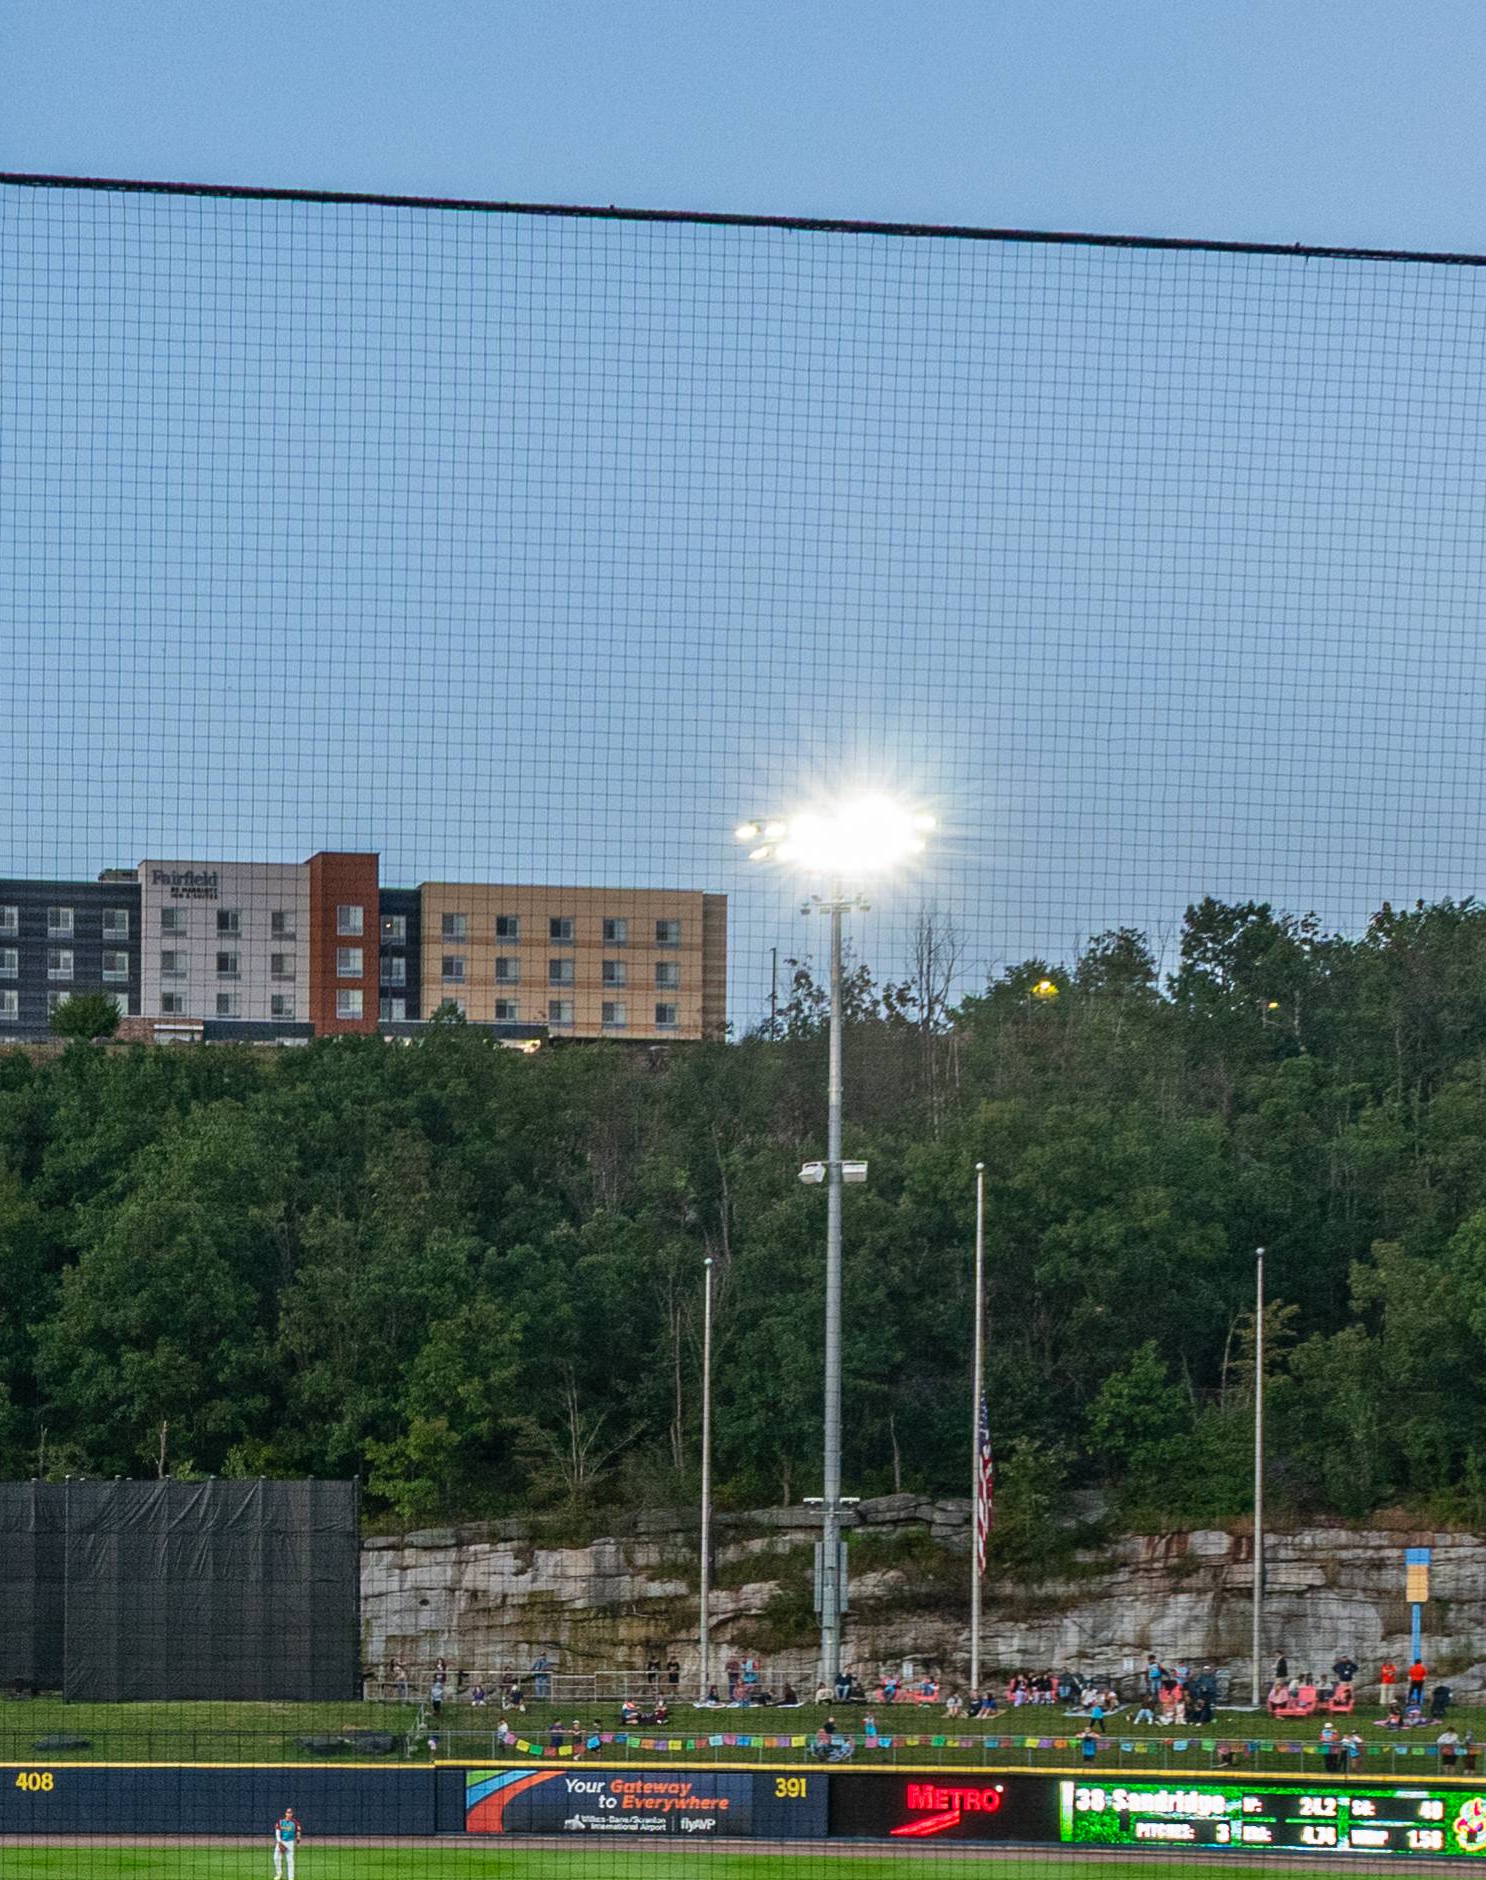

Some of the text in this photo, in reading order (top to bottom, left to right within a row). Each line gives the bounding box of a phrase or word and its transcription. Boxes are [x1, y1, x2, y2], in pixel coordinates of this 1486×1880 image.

[152, 870, 218, 887] Fairfield
[15, 1771, 54, 1793] 408
[565, 1779, 692, 1796] Your Gateway
[775, 1777, 807, 1798] 391
[598, 1795, 729, 1813] to Everywhere
[906, 1784, 1001, 1812] METRO
